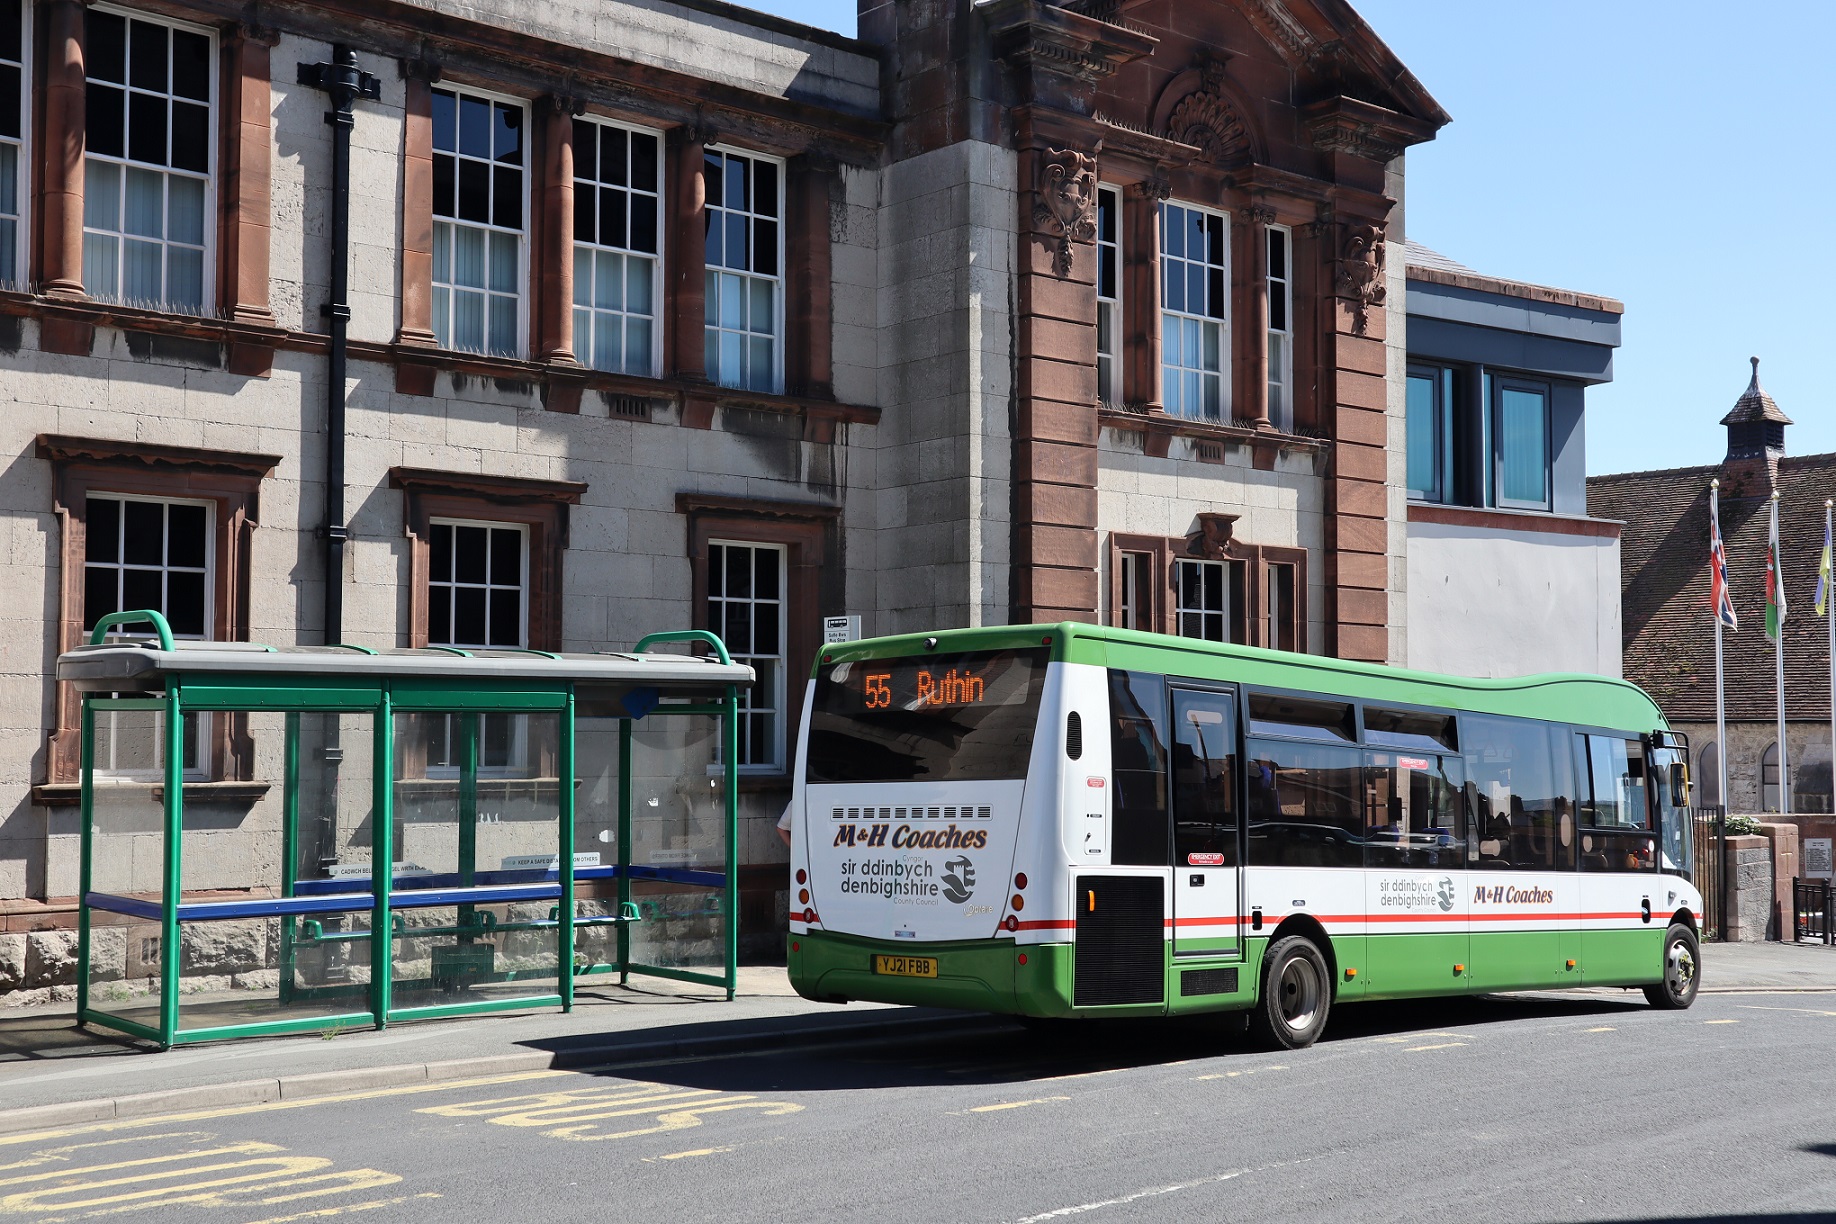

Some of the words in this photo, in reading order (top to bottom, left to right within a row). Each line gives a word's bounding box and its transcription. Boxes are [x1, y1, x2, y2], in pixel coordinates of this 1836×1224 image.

[865, 673, 891, 708] 55
[917, 668, 984, 705] Ruthin
[833, 823, 890, 848] M&H
[891, 823, 988, 850] Coaches
[902, 854, 924, 863] Cyngor
[841, 858, 857, 875] sir
[861, 859, 933, 880] ddinbych
[841, 876, 939, 899] denbighshire
[1380, 879, 1390, 892] sir
[1391, 879, 1433, 895] ddinbych
[1473, 885, 1504, 904] M&H
[1506, 885, 1554, 904] Coaches
[893, 897, 914, 906] County
[915, 897, 939, 906] Council
[1380, 893, 1437, 909] denbighshire
[882, 957, 906, 973] YJ21
[908, 959, 930, 974] FBB
